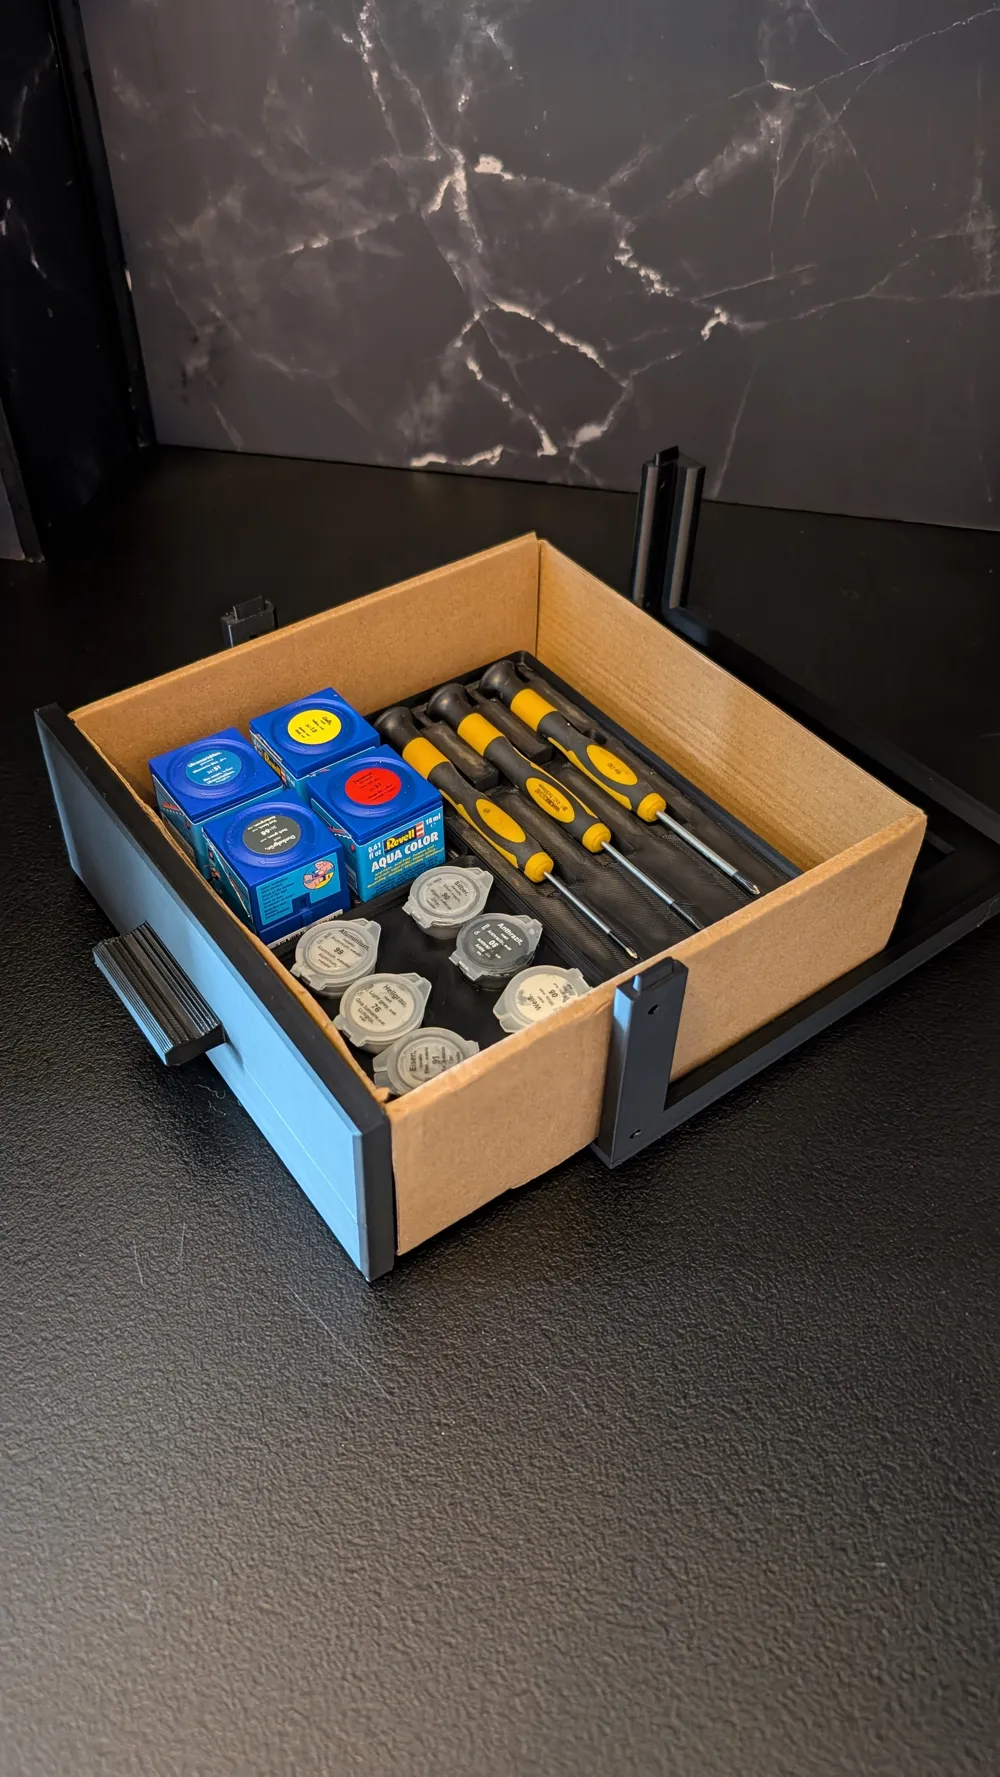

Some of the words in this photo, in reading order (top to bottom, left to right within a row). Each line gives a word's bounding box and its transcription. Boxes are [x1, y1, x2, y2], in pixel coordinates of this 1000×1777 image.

[368, 842, 381, 853] 0.61
[385, 829, 415, 850] Revell
[371, 849, 402, 873] AQUA
[404, 831, 439, 855] COLOR
[497, 923, 523, 946] Anthrazit,
[333, 947, 344, 955] 99
[383, 984, 407, 1008] Hellgrau,
[548, 989, 558, 998] 05
[371, 1003, 382, 1012] 76
